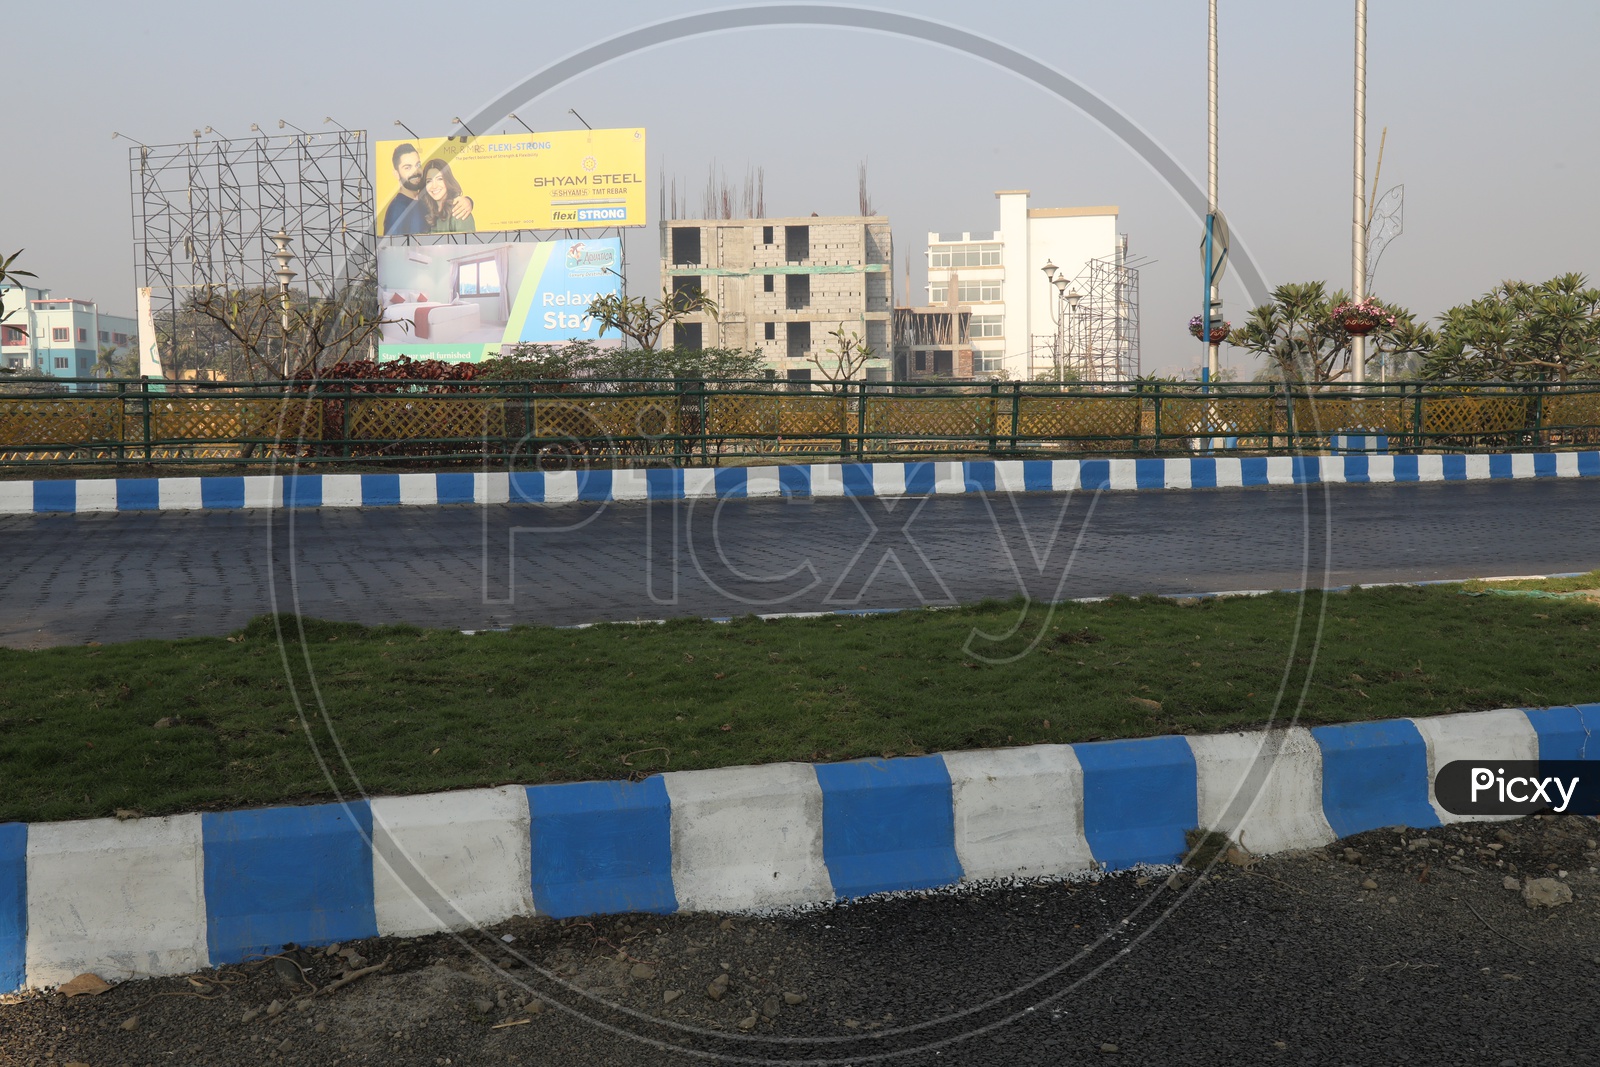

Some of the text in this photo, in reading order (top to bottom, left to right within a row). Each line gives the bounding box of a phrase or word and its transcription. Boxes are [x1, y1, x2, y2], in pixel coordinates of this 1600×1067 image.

[459, 146, 466, 154] &
[488, 141, 551, 152] FLEXI-STRONG
[533, 173, 643, 187] SHYAM STEEL
[558, 188, 582, 197] SHYAM
[606, 187, 628, 195] REBAR
[543, 311, 595, 332] Stay
[381, 352, 396, 361] Stay
[420, 351, 435, 360] well
[437, 351, 471, 360] furnished
